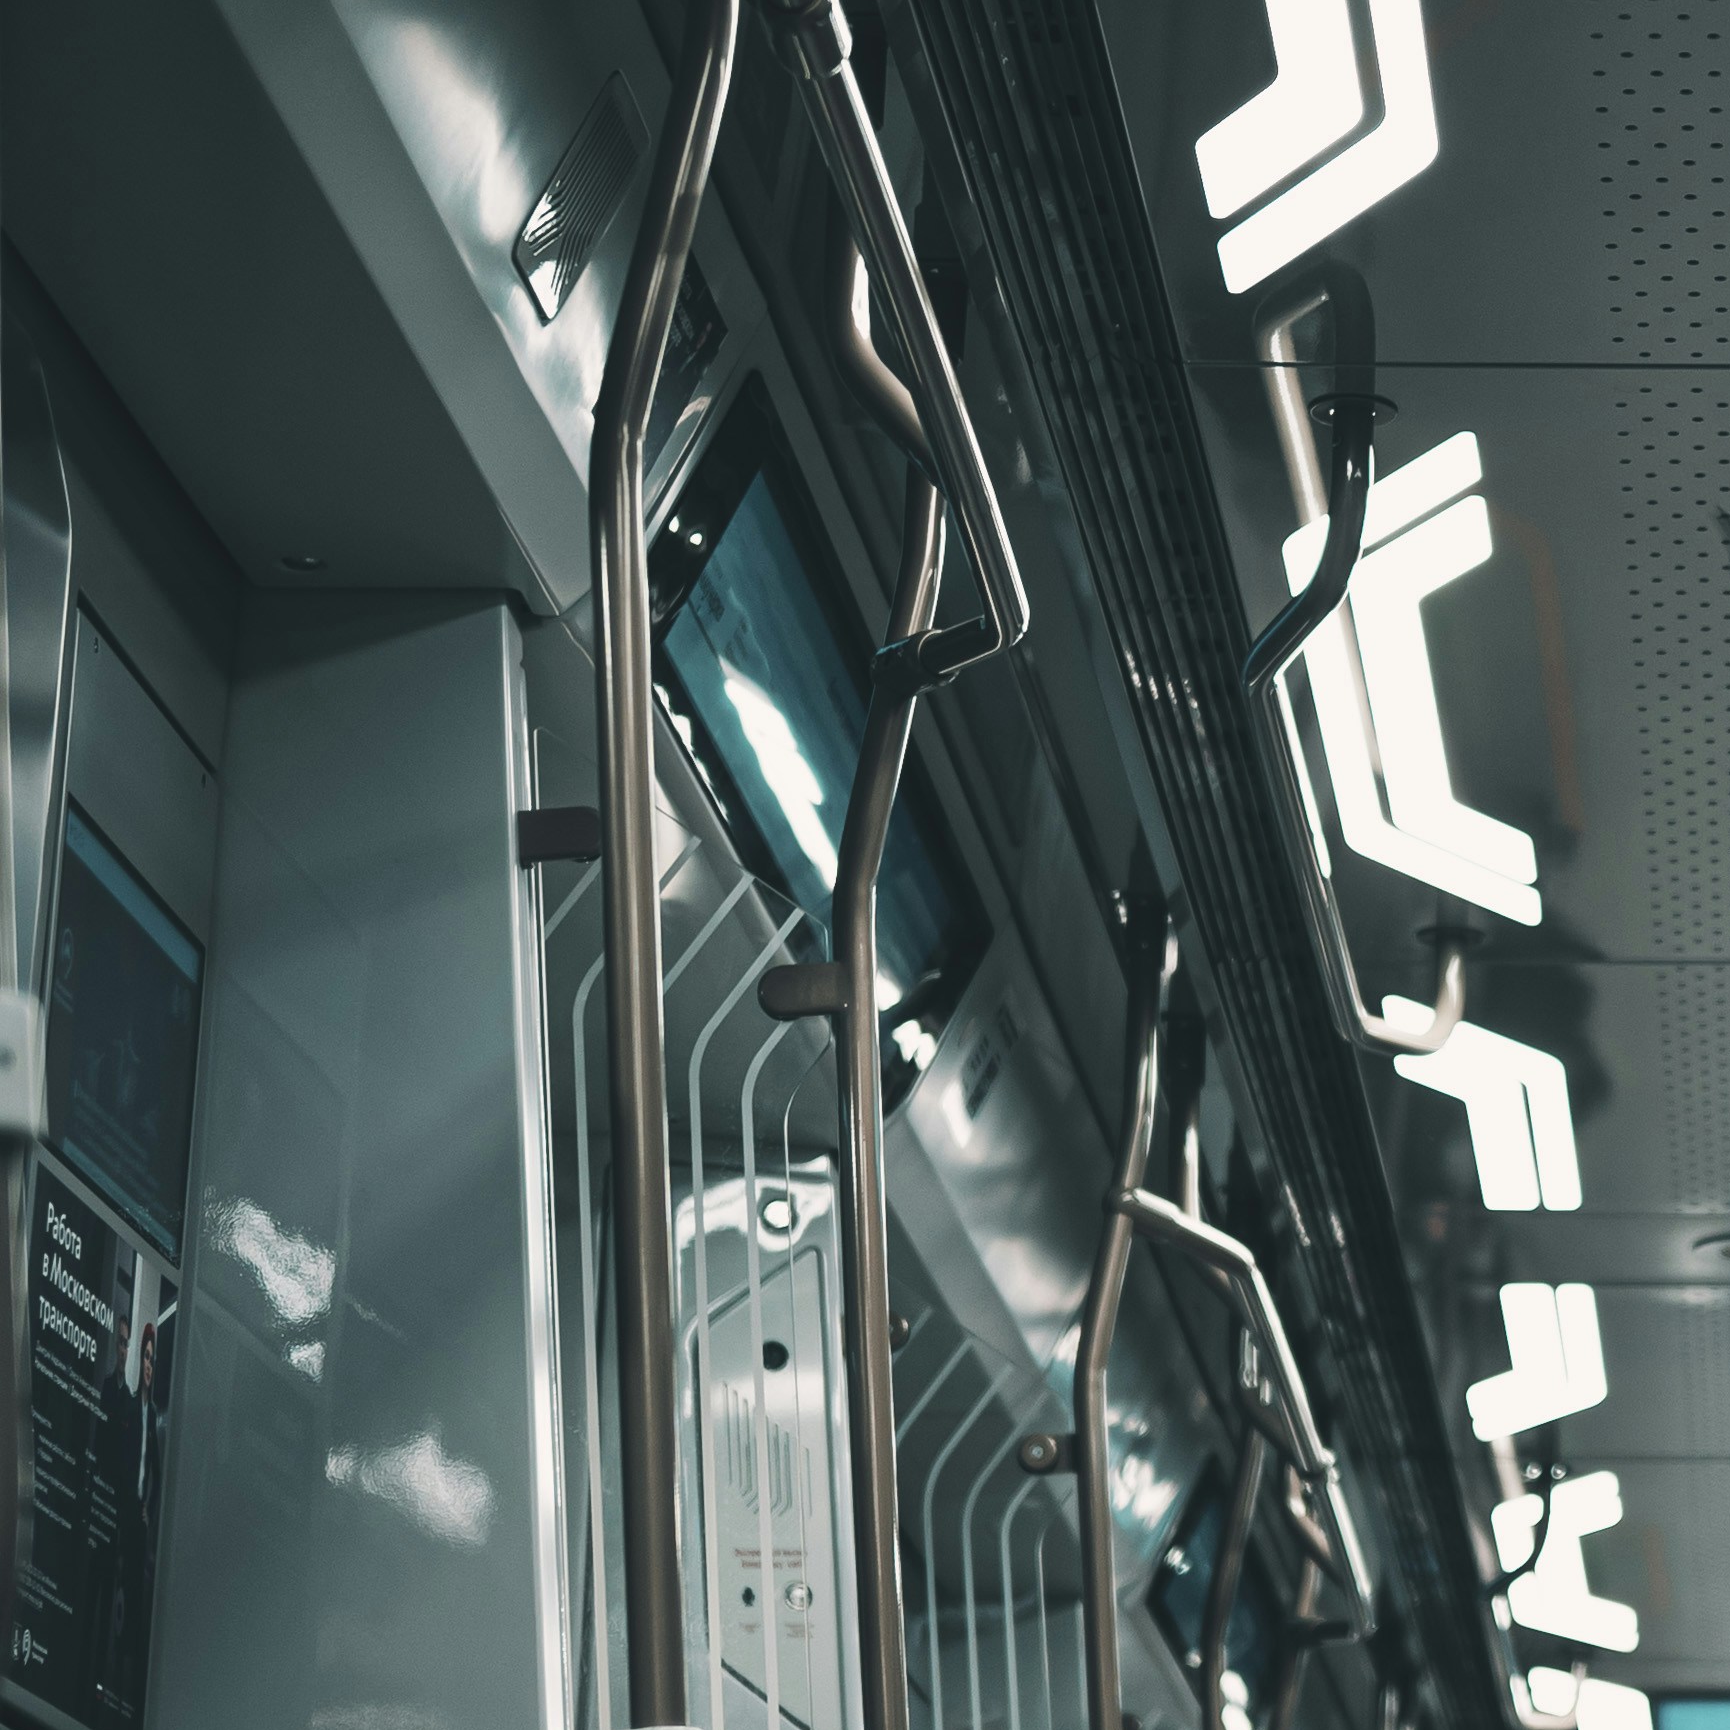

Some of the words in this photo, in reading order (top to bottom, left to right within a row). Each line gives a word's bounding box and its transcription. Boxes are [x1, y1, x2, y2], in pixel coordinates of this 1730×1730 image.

[45, 1201, 82, 1260] Работа
[42, 1252, 49, 1278] в
[49, 1252, 114, 1334] Московском
[38, 1295, 97, 1363] транспорте
